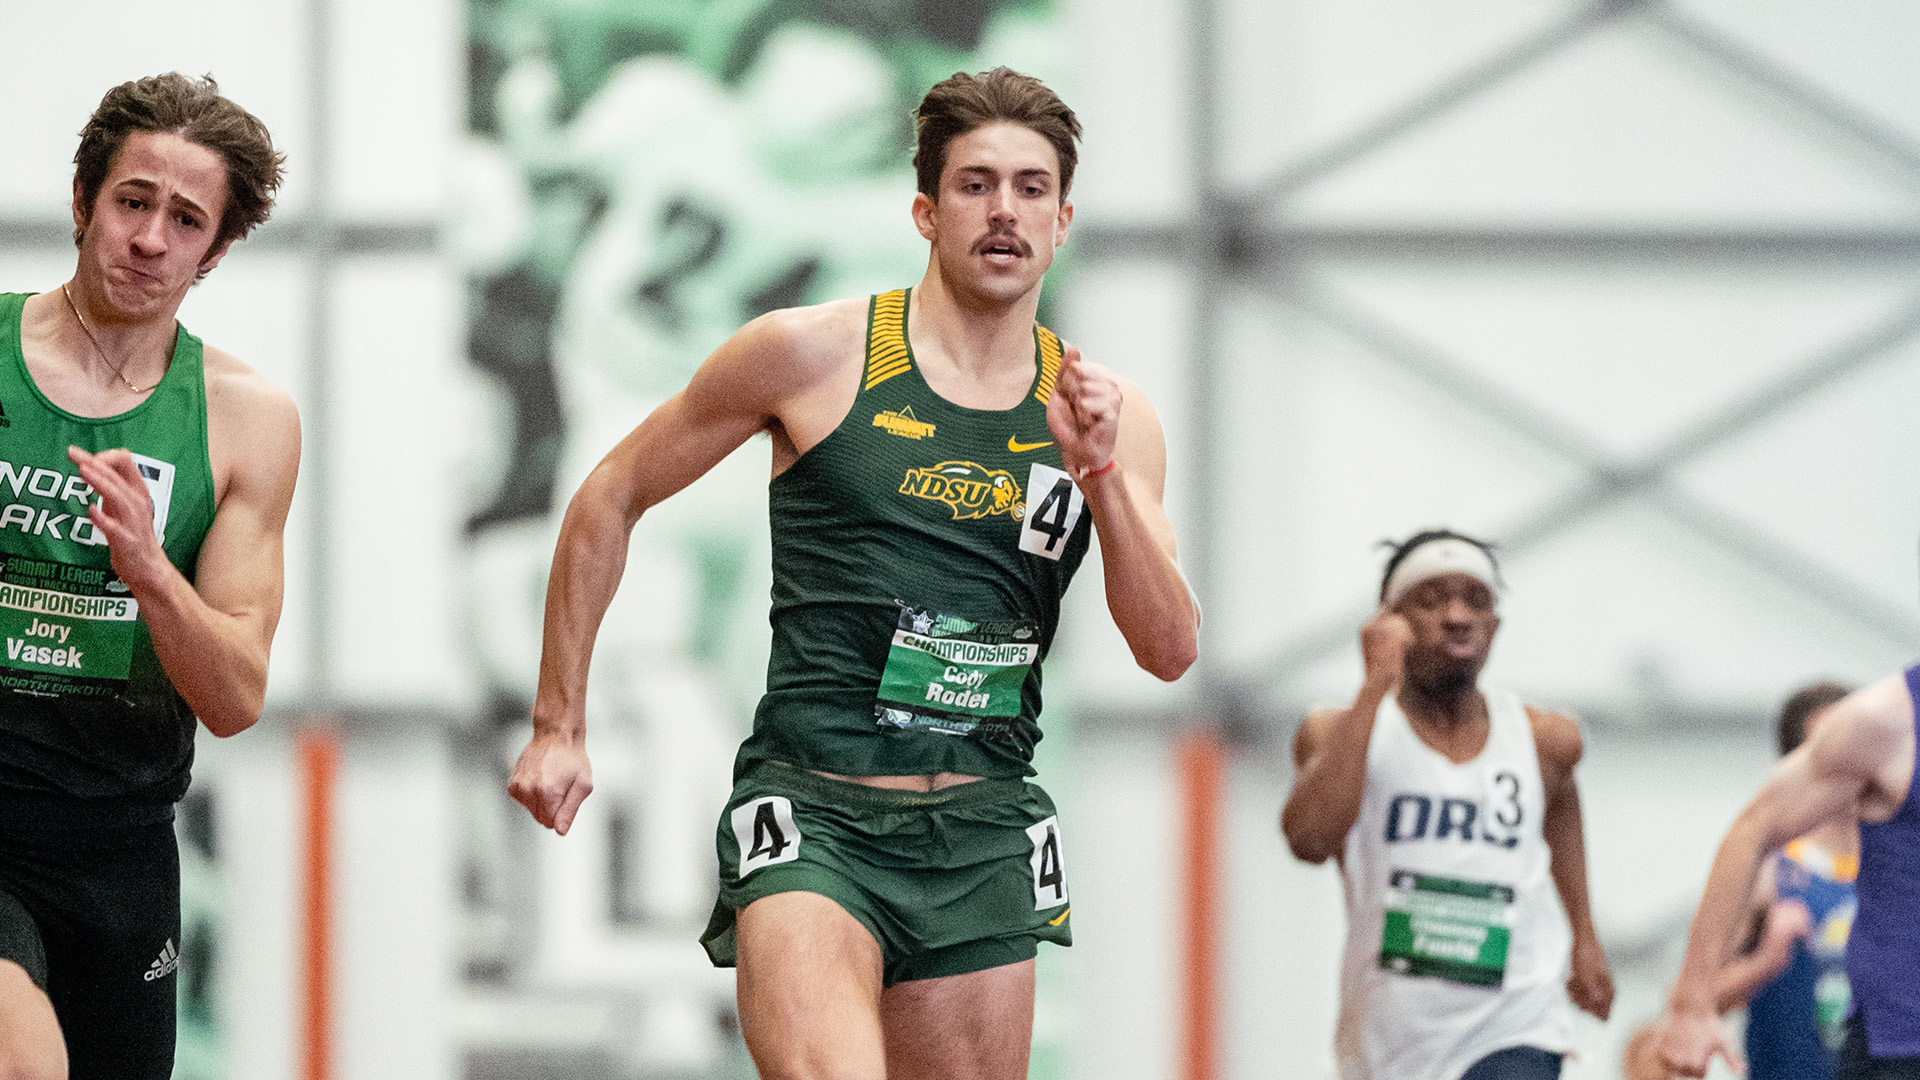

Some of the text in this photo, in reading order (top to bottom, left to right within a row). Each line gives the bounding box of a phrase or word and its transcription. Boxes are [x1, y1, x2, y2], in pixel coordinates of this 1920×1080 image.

[0, 460, 95, 505] NOR
[898, 469, 991, 509] NDSU
[0, 503, 96, 546] AKO
[1029, 477, 1073, 552] 4
[7, 557, 106, 586] SUMMIT LEAGUE
[25, 618, 71, 642] Jory
[6, 637, 84, 669] Vasek
[902, 635, 1028, 663] CHAMPIONSHIPS
[0, 675, 48, 690] NORTH
[925, 682, 990, 709] Roder
[943, 666, 988, 690] Cody
[1496, 772, 1522, 827] 3
[747, 801, 792, 860] 4
[1039, 824, 1063, 900] 4
